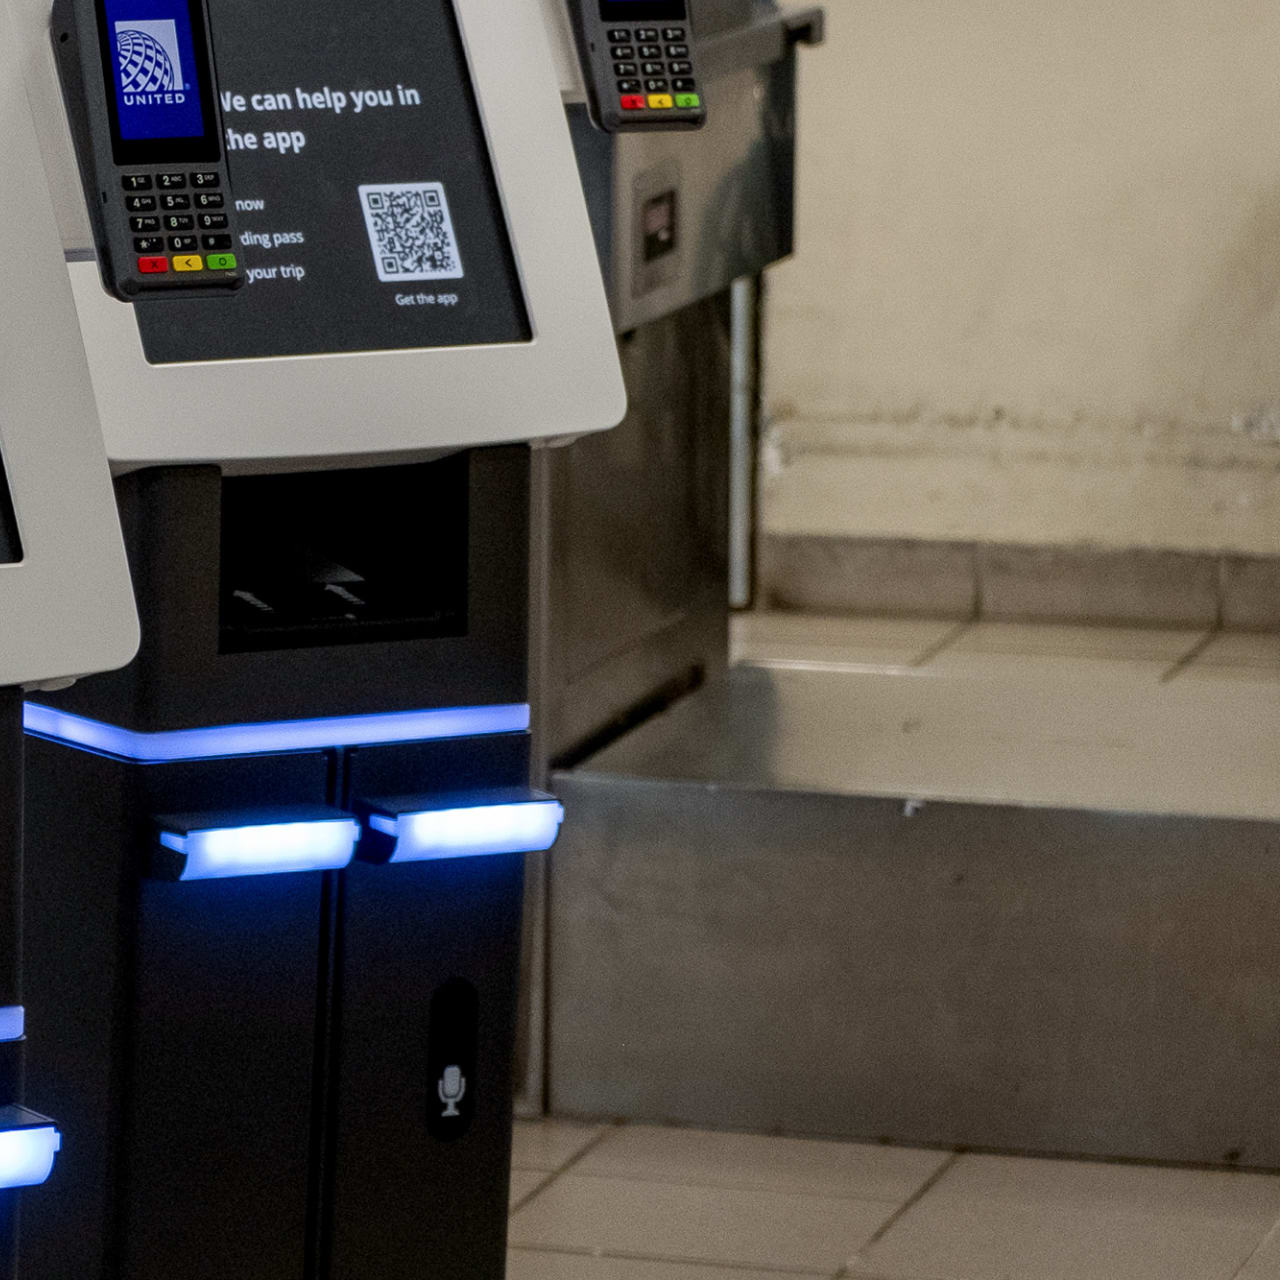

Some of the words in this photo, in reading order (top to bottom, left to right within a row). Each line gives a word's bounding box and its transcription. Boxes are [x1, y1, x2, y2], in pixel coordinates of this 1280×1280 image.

[123, 92, 186, 106] UNITED
[250, 93, 293, 112] can
[295, 86, 347, 114] help
[349, 89, 394, 113] you
[396, 84, 422, 106] in
[262, 130, 306, 155] app
[162, 175, 171, 186] 2
[196, 174, 204, 184] 3
[133, 198, 140, 208] 4
[167, 196, 174, 206] 5
[200, 195, 208, 205] 6
[234, 199, 265, 212] now
[136, 218, 143, 229] 7
[170, 217, 177, 227] 8
[204, 215, 211, 226] 9
[174, 238, 181, 248] 0
[272, 231, 305, 248] pass
[245, 267, 278, 284] your
[279, 263, 306, 281] trip
[394, 293, 416, 306] Get
[415, 292, 436, 305] the
[436, 293, 459, 307] app
